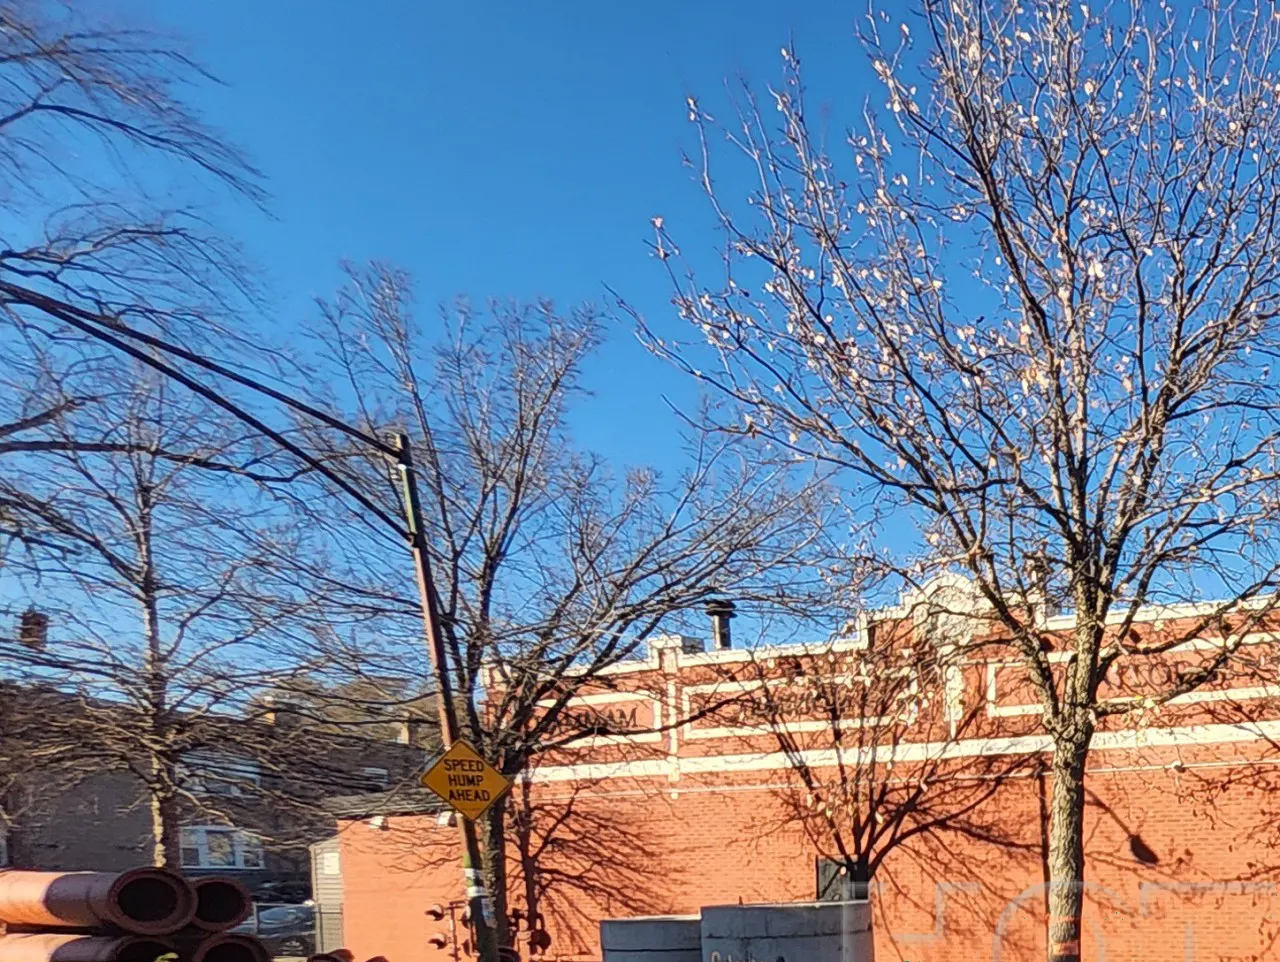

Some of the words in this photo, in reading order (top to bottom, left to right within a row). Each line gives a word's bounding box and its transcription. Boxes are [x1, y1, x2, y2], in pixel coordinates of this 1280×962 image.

[443, 759, 485, 772] SPEED
[448, 774, 484, 787] HUMP
[448, 789, 491, 802] AHEAD
